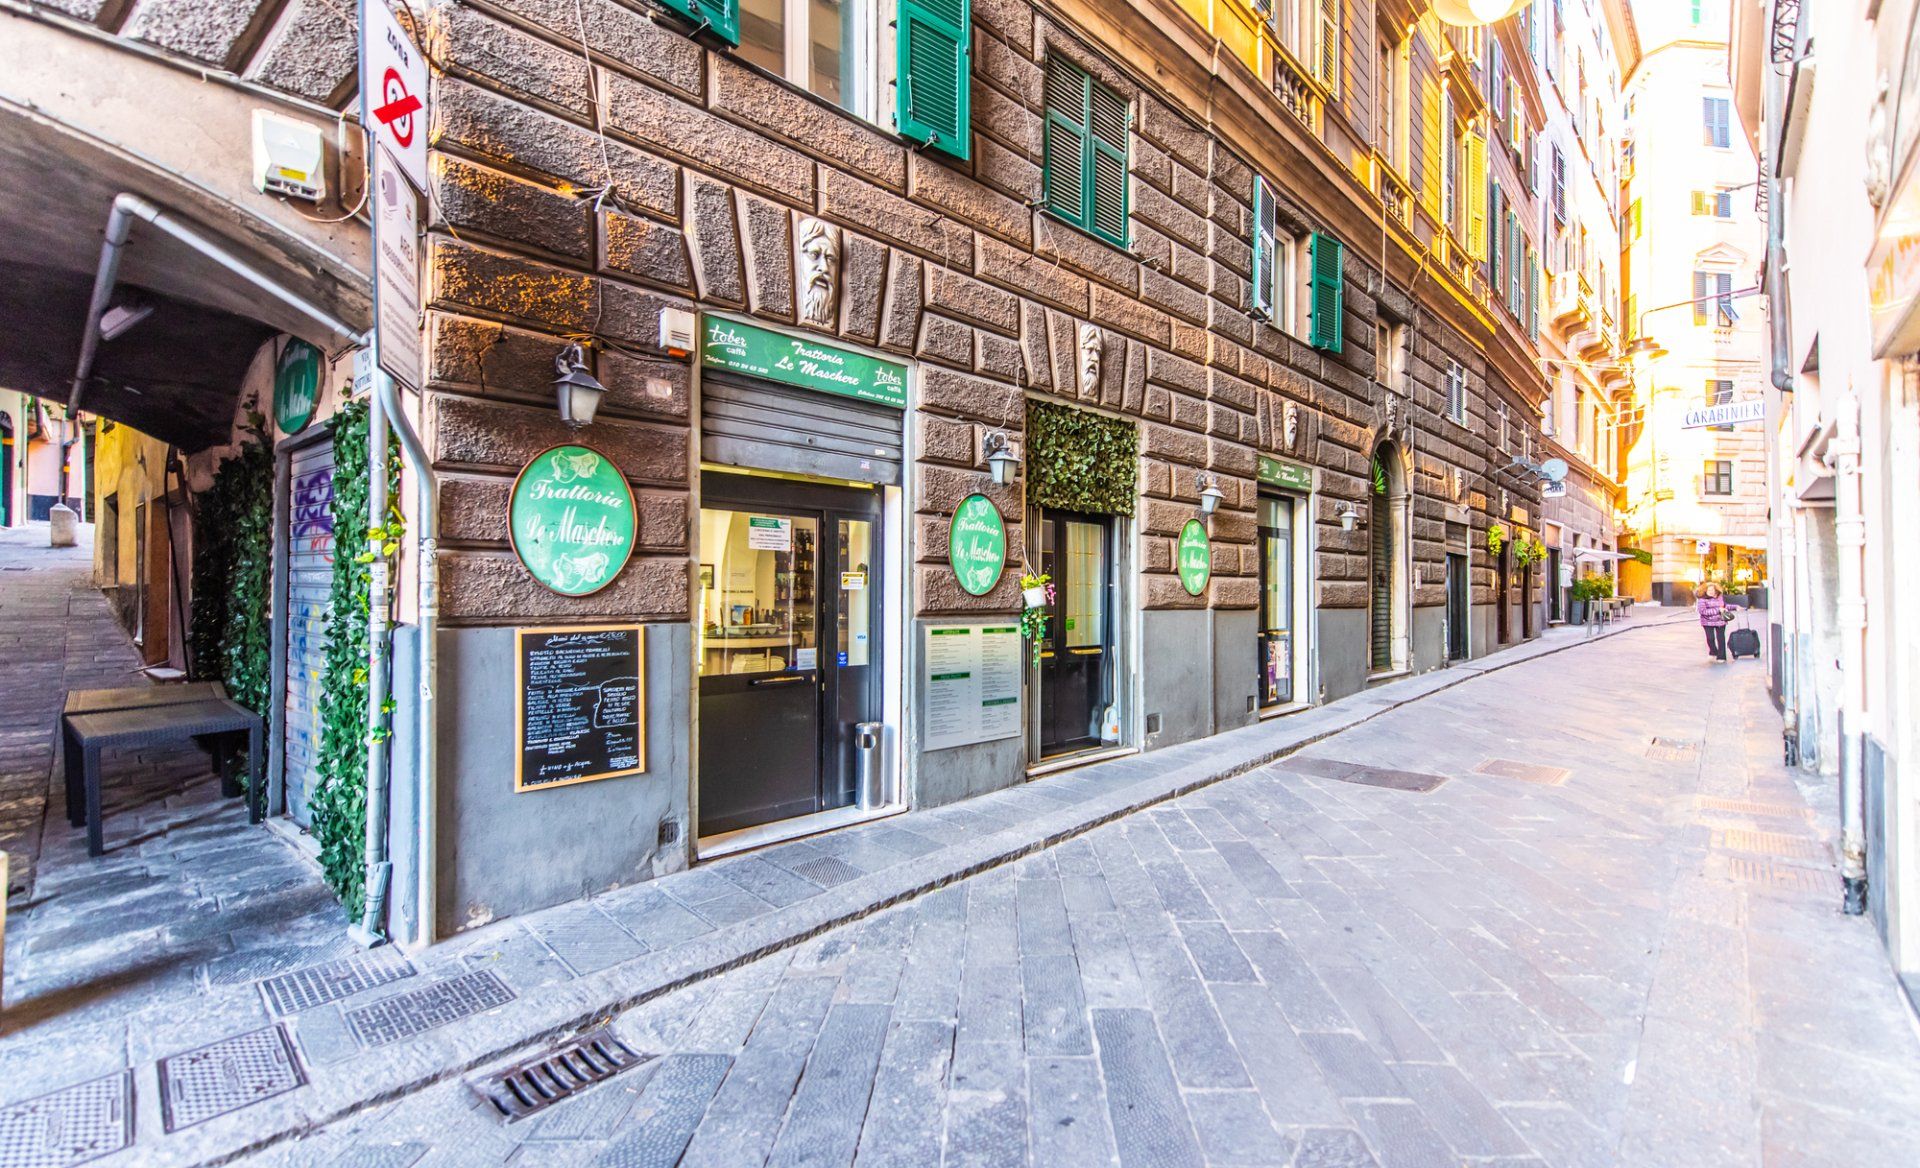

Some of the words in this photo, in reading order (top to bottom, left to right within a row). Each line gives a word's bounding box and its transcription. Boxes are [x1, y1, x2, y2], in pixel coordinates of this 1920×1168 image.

[387, 26, 410, 69] Zona
[708, 324, 747, 347] tober
[791, 341, 845, 366] Trattoria
[774, 355, 794, 371] Le
[799, 360, 860, 385] Maschere
[874, 366, 902, 386] tober
[1685, 402, 1766, 426] CARABINIERI
[530, 479, 624, 508] Trattoria
[526, 513, 547, 542] Le
[549, 505, 625, 546] Maschere
[957, 517, 1000, 537] Trattoria
[955, 540, 966, 560] Le
[965, 535, 1000, 563] Maschere
